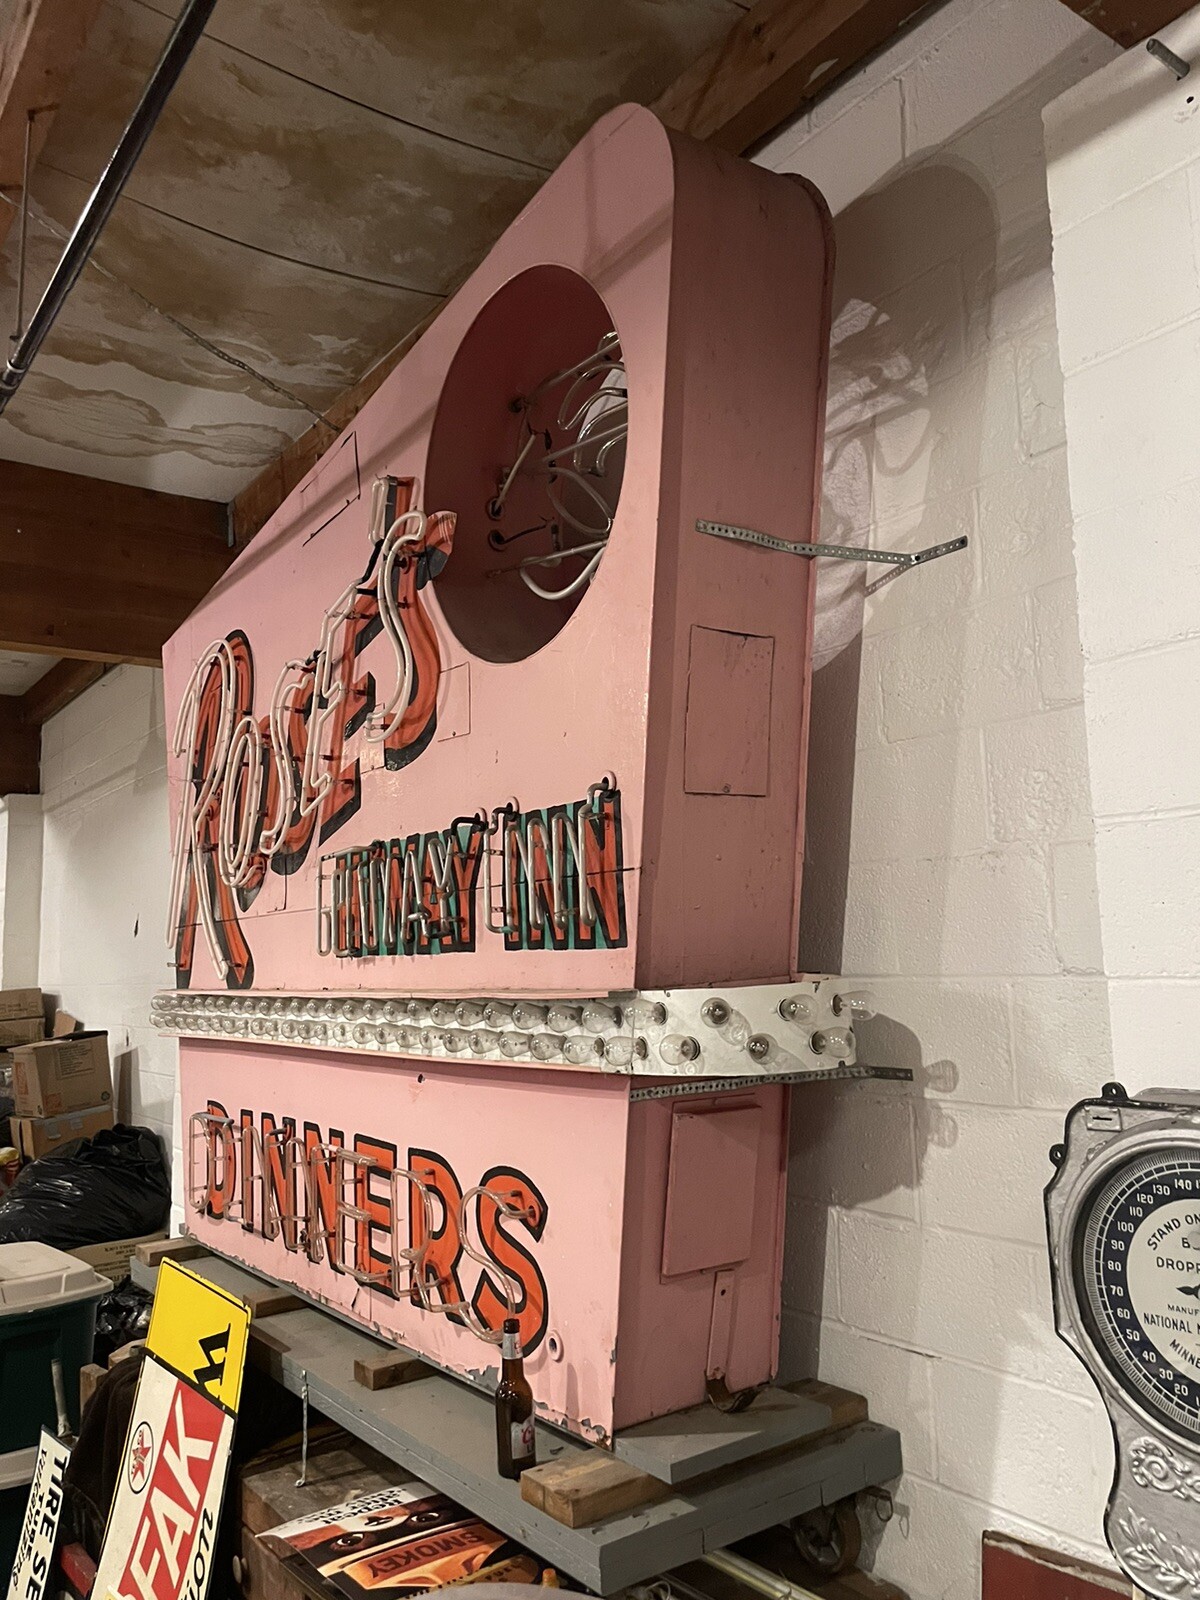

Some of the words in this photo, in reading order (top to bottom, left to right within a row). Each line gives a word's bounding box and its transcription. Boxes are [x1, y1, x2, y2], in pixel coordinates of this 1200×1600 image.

[484, 782, 629, 952] INN
[1153, 1184, 1171, 1196] 130
[1174, 1179, 1192, 1190] 140
[1136, 1193, 1154, 1205] 120
[1129, 1206, 1143, 1217] 110
[188, 1099, 549, 1359] DINNERS
[1117, 1221, 1135, 1233] 100
[1147, 1217, 1181, 1251] STAND
[1110, 1239, 1125, 1251] 90
[1107, 1260, 1122, 1272] 80
[1110, 1285, 1124, 1297] 70
[1116, 1307, 1131, 1320] 60
[1143, 1312, 1193, 1334] NATIONAL
[1125, 1328, 1140, 1341] 50
[1142, 1350, 1157, 1363] 40
[1158, 1367, 1174, 1381] 30
[1173, 1382, 1189, 1396] 20
[39, 1455, 68, 1544] TIRE
[368, 1531, 486, 1580] SMOKEY
